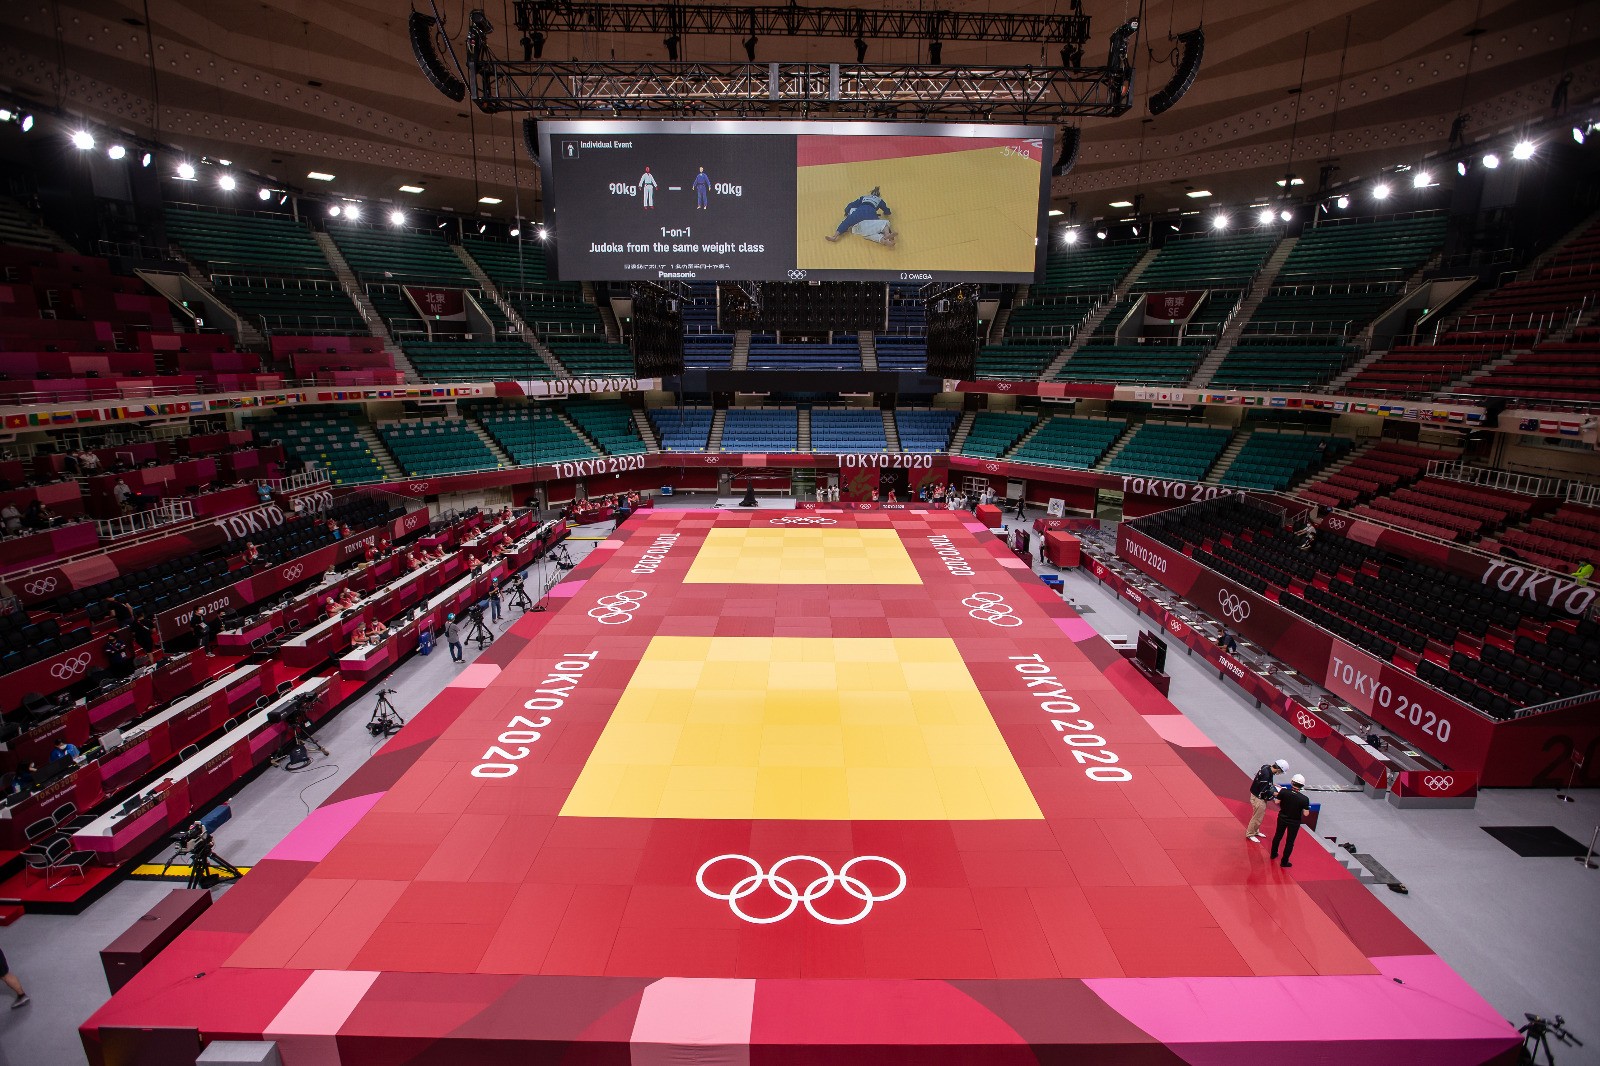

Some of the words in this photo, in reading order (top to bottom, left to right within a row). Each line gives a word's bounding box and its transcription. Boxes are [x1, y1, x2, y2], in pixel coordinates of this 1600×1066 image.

[580, 140, 612, 149] Individual
[614, 141, 633, 149] Event
[609, 183, 637, 197] 90kg
[714, 183, 742, 197] 90kg
[660, 226, 691, 238] 1-on-1
[589, 242, 624, 253] Judoka
[626, 242, 650, 253] from
[653, 242, 669, 253] the
[672, 244, 699, 253] same
[701, 242, 736, 255] weight
[738, 242, 765, 253] class
[430, 303, 443, 313] NE
[1168, 307, 1180, 317] SE
[546, 378, 599, 395] TOKYO
[602, 378, 639, 392] 2020
[552, 459, 606, 479] TOKYO
[610, 455, 645, 473] 2020
[836, 454, 889, 468] TOKYO
[893, 454, 932, 469] 2020
[1121, 475, 1187, 500] TOKYO
[213, 505, 284, 542] TOKYO
[344, 540, 362, 554] TOKYO
[646, 533, 681, 554] TOKYO
[926, 535, 960, 556] TOKYO
[631, 555, 666, 574] 2020
[941, 556, 976, 576] 2020
[1125, 538, 1148, 562] TOKYO
[1148, 551, 1168, 573] 2020
[1481, 559, 1596, 615] TOKYO
[174, 606, 207, 627] TOKO
[207, 596, 230, 614] 2020
[524, 650, 599, 710] TOKYO
[1333, 656, 1392, 708] TOKYO
[1394, 696, 1451, 743] 2020
[1008, 653, 1081, 713] TOKYO
[1050, 719, 1133, 782] 2020
[471, 715, 552, 778] 2020
[35, 784, 60, 801] TOKYO
[60, 773, 79, 787] 2020
